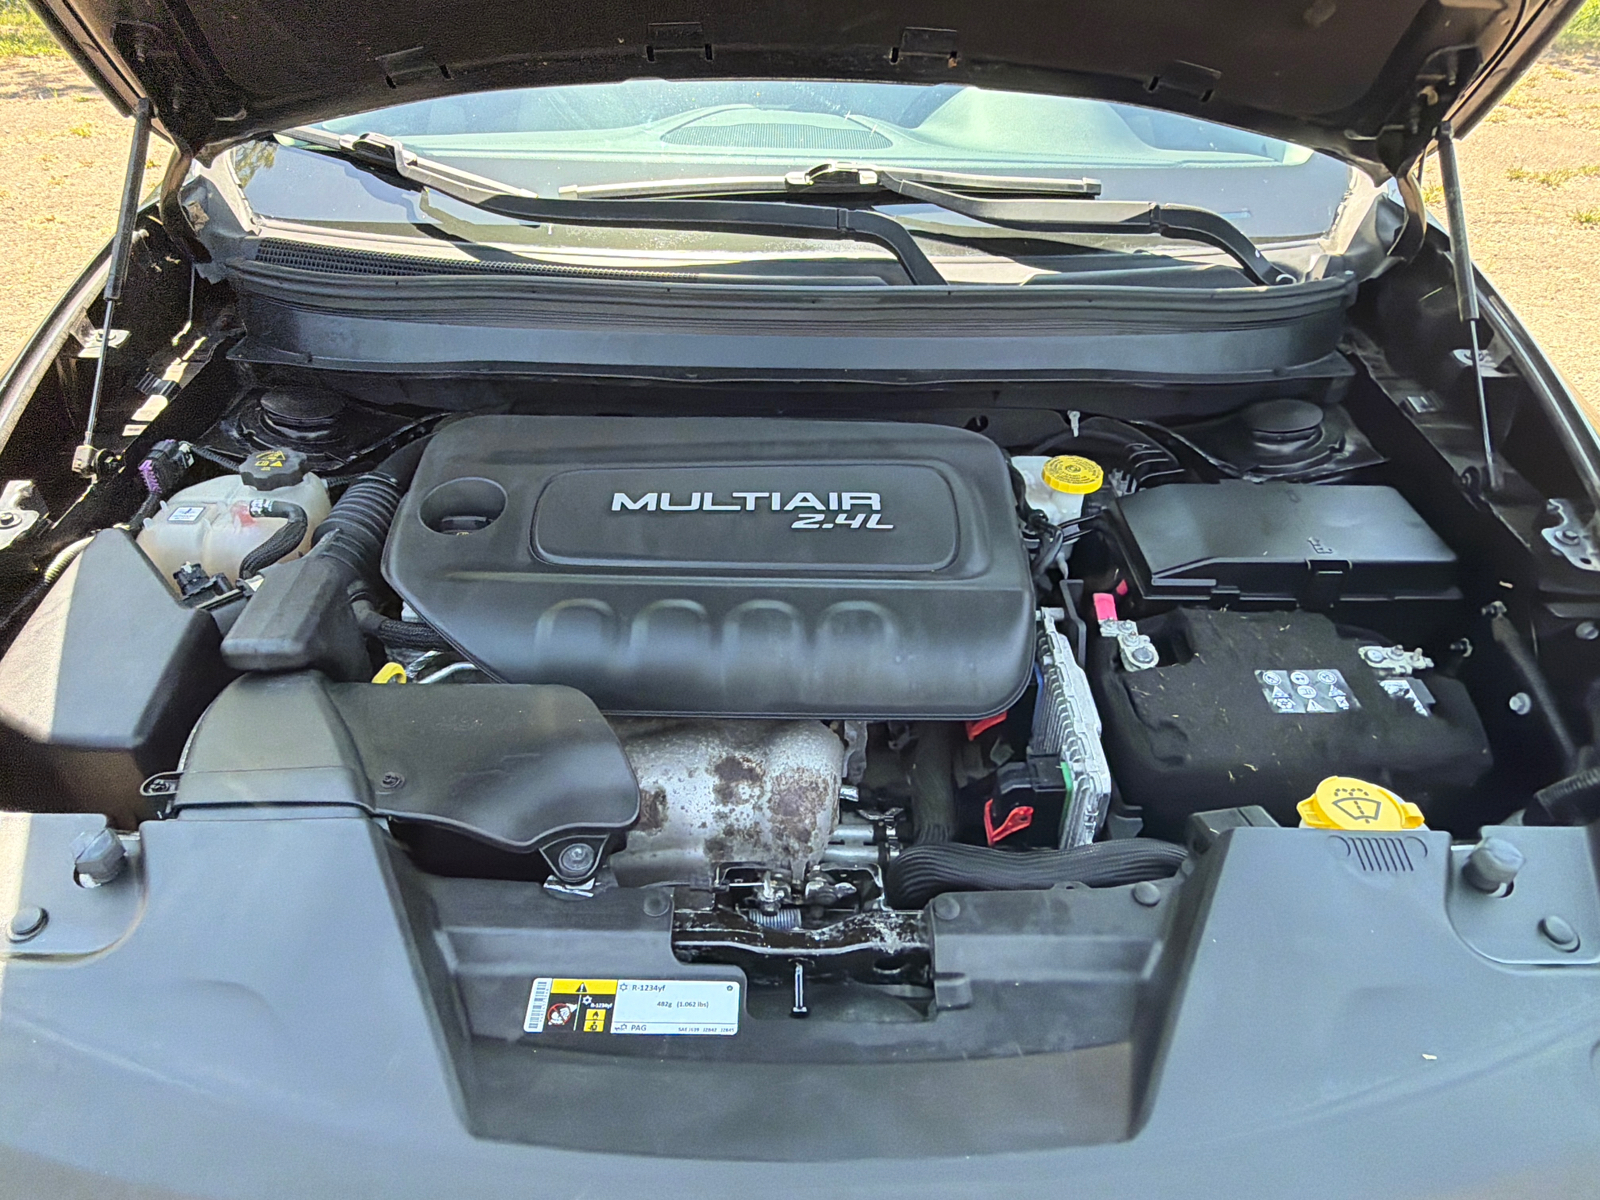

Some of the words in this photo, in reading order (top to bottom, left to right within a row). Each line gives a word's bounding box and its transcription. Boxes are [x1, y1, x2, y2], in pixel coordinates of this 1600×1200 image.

[611, 492, 881, 511] MULTIAIR
[791, 513, 894, 529] 2.4L
[631, 984, 666, 993] R-1234yf
